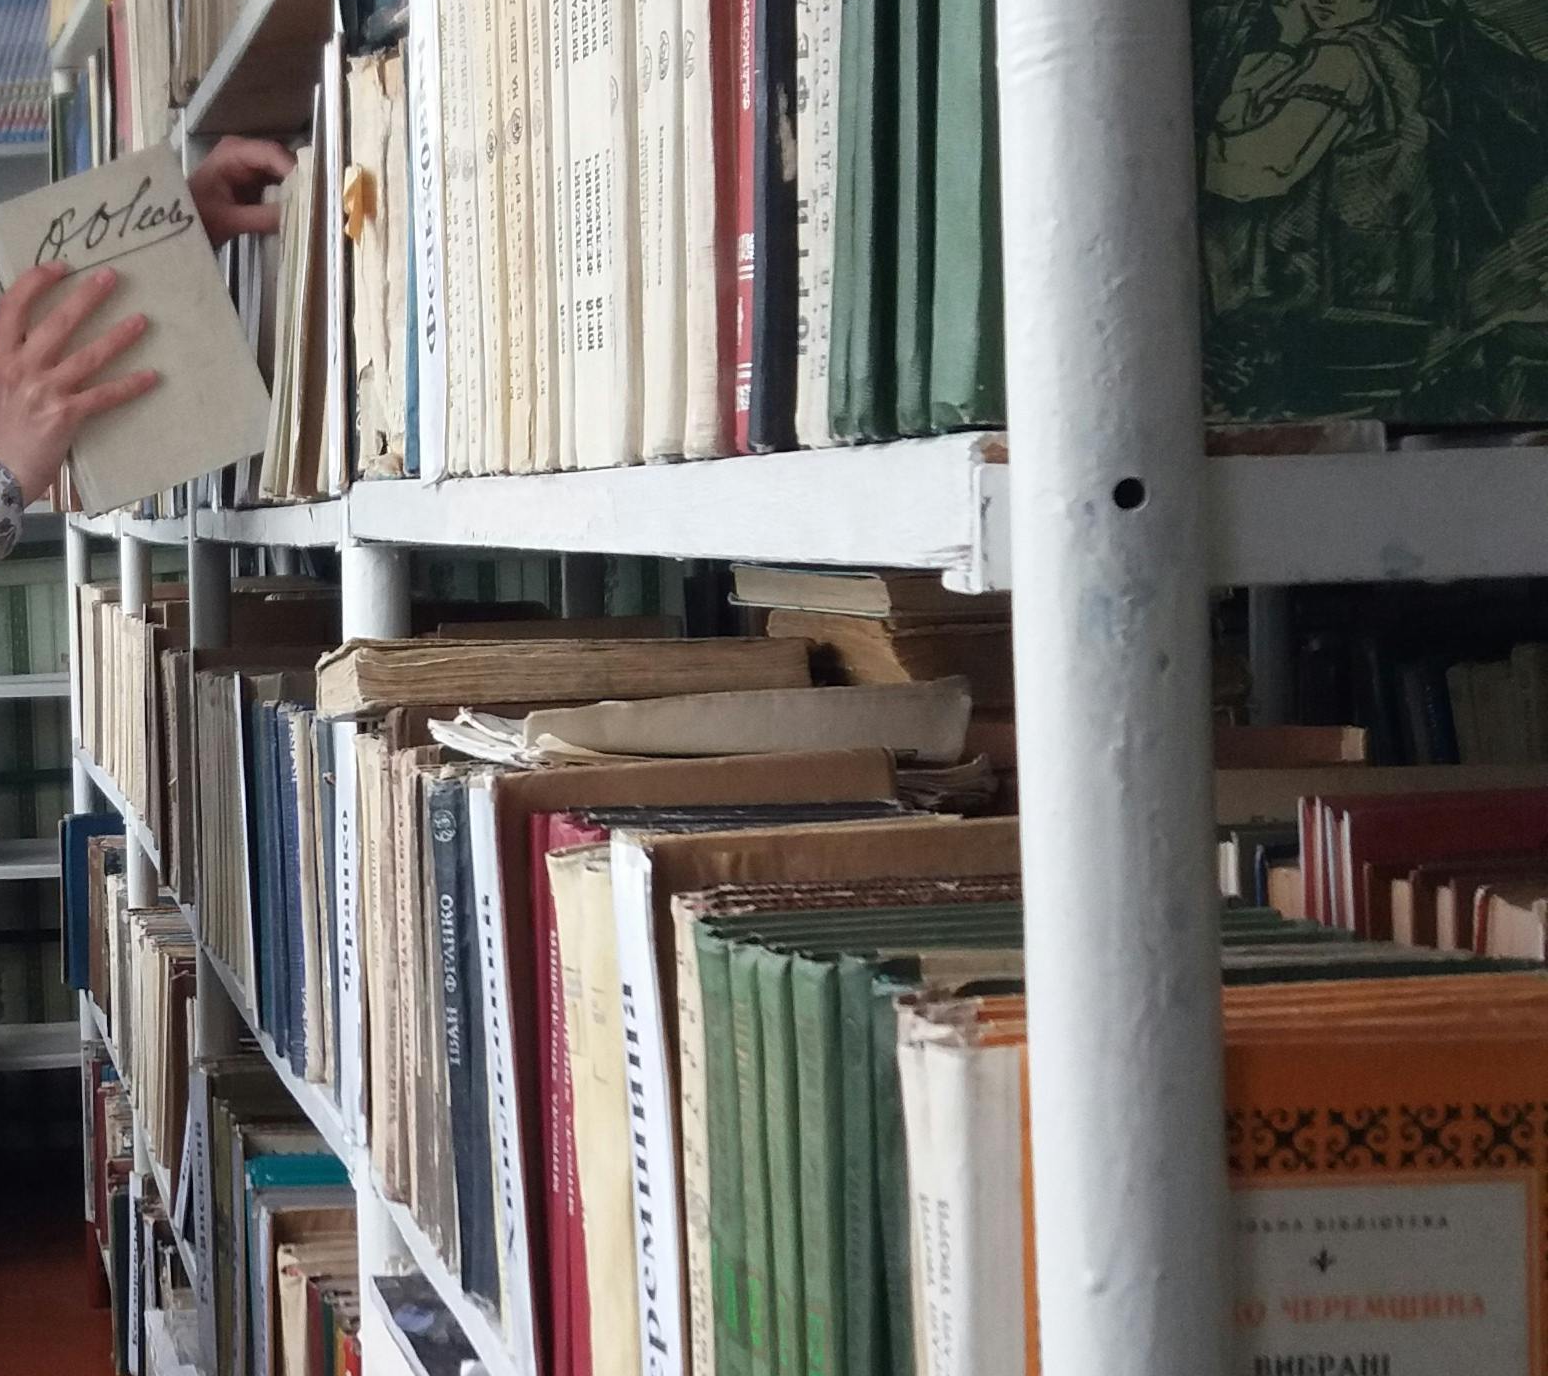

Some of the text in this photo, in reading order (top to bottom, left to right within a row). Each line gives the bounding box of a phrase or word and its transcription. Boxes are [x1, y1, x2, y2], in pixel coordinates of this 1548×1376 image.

[440, 892, 461, 1066] ІВАН ФРАНКО
[1280, 1293, 1487, 1323] ЧЕРЕМШИНА
